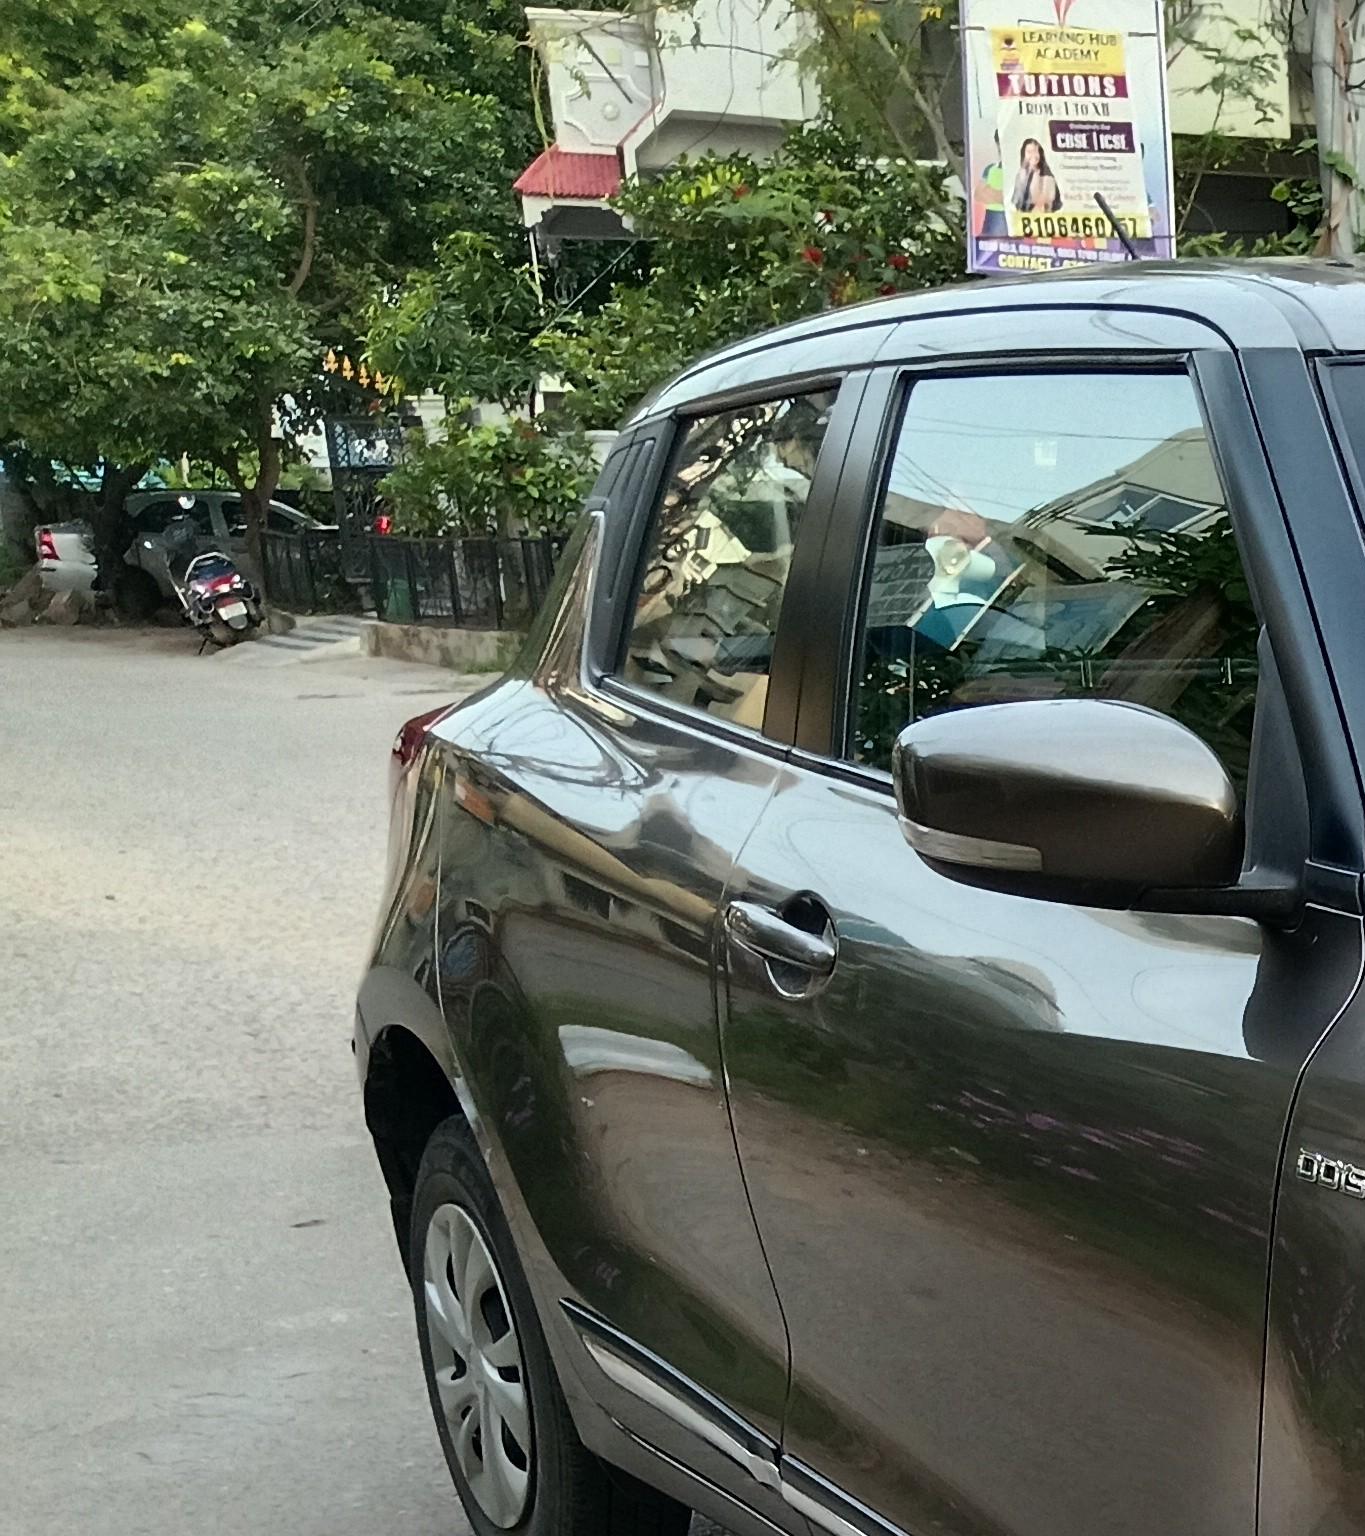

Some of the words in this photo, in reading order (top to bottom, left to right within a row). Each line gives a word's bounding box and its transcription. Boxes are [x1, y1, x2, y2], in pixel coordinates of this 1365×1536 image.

[1089, 32, 1118, 46] HUB
[1035, 48, 1100, 62] ACADEMY
[1007, 73, 1117, 97] TUITIONS
[998, 253, 1052, 270] CONTACT
